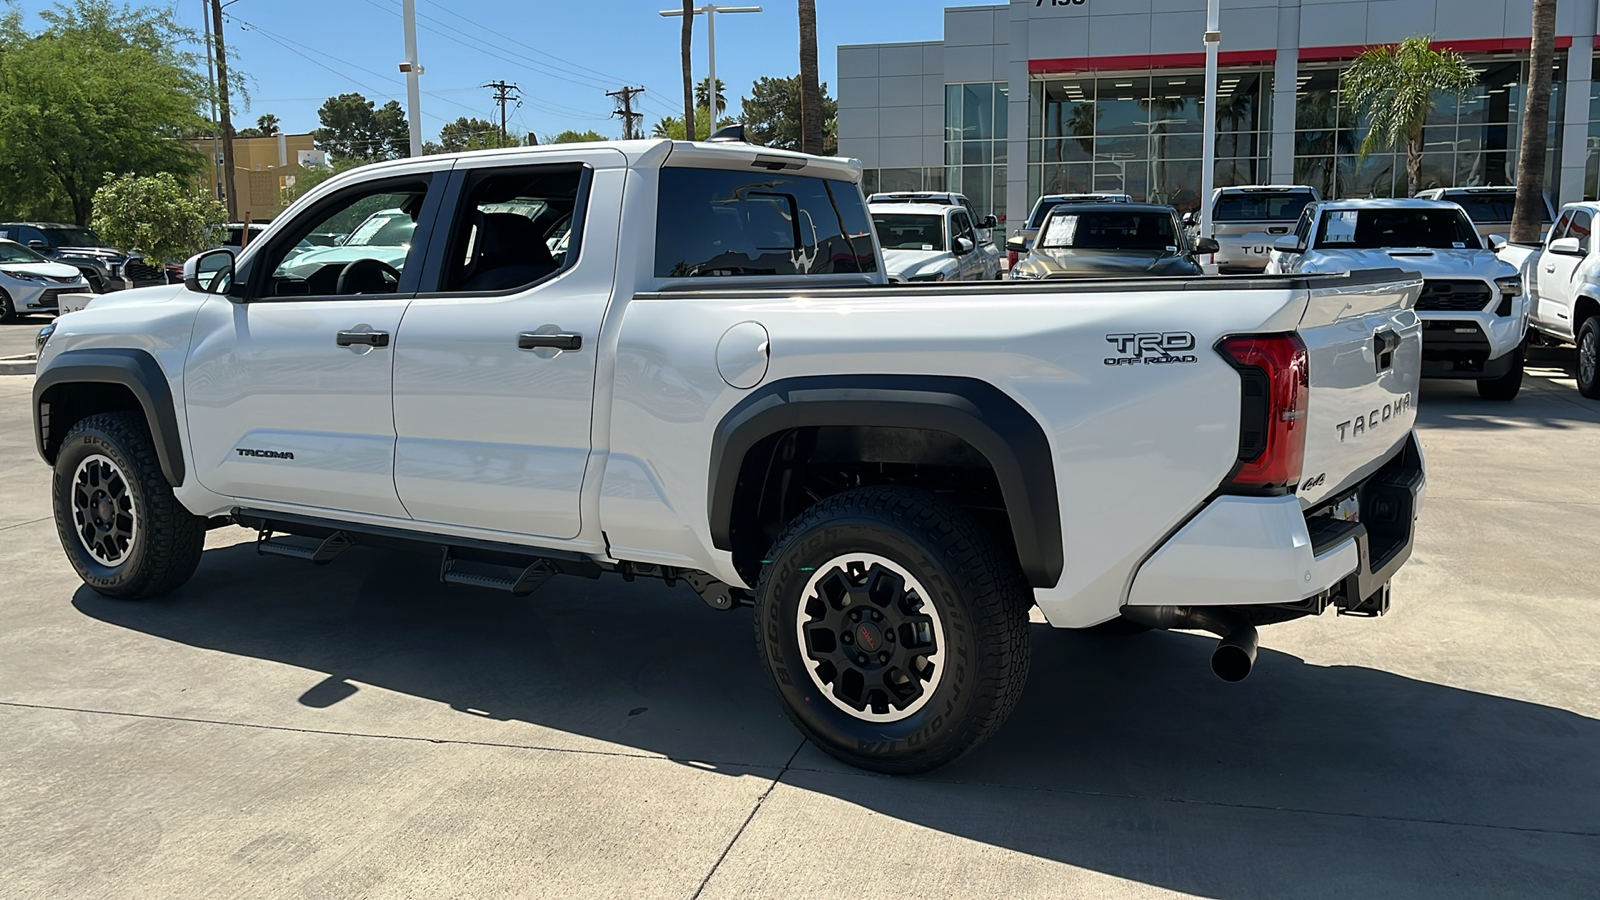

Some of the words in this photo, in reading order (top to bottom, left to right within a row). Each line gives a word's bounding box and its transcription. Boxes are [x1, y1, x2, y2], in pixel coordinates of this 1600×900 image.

[1105, 331, 1196, 357] TRD
[1103, 357, 1141, 366] OFF
[1143, 355, 1198, 365] ROAD
[1336, 393, 1411, 442] TACOMA
[235, 448, 294, 460] TACOMA
[767, 528, 838, 687] BFGoodrich
